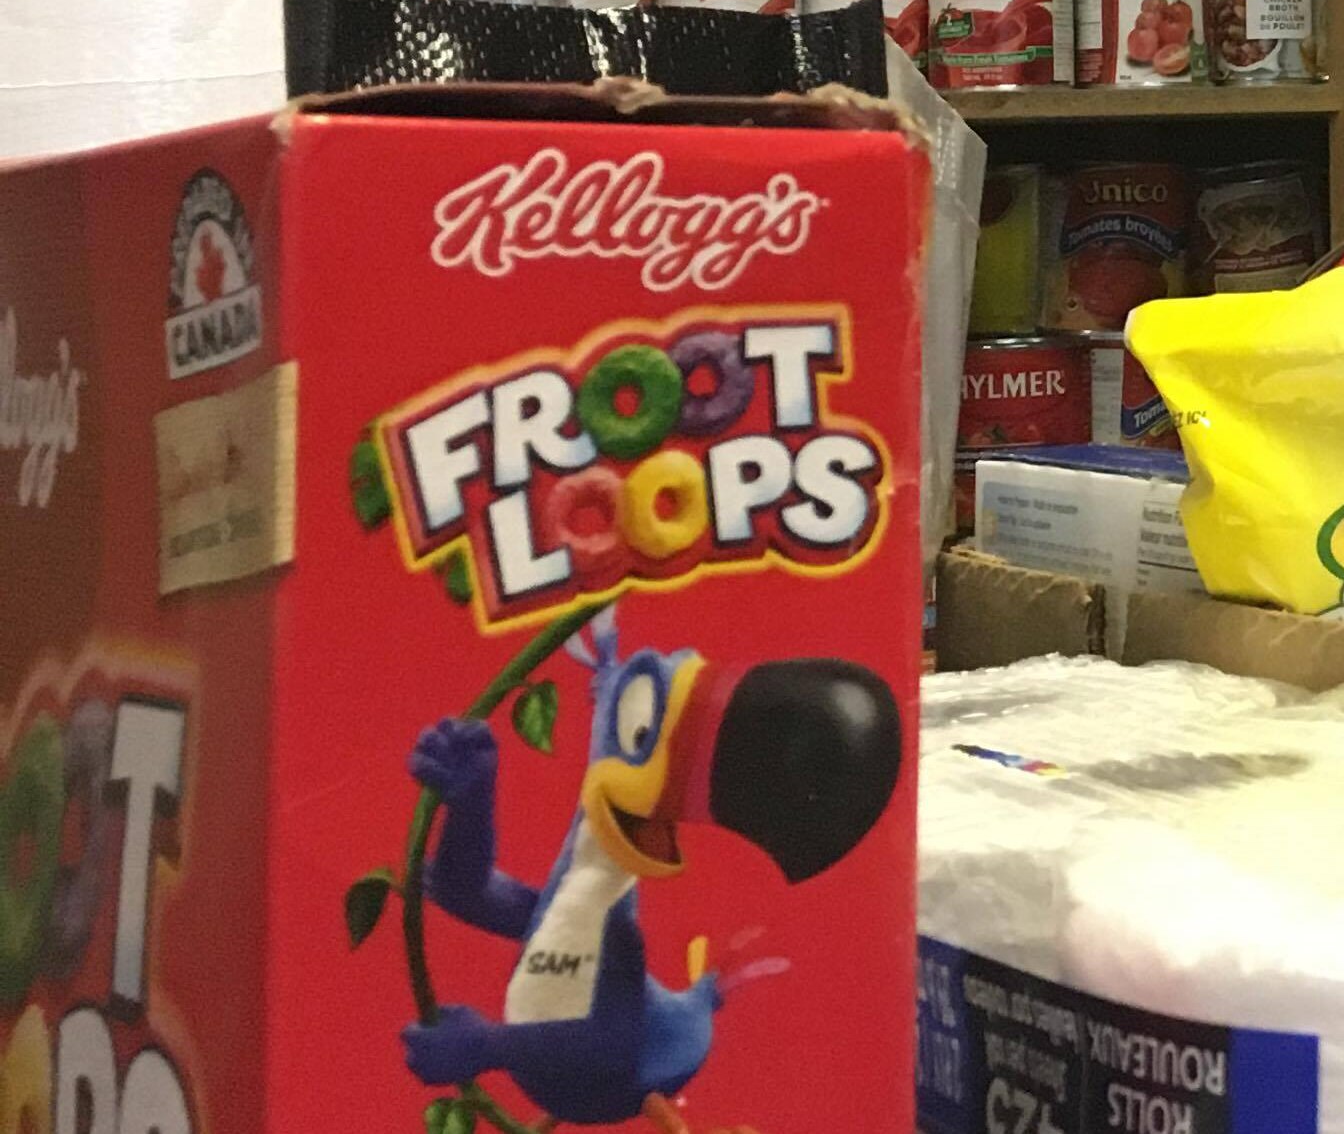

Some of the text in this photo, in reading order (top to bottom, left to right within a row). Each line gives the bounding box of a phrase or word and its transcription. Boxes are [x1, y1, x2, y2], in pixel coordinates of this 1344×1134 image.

[1260, 13, 1305, 23] BOUILLON
[1268, 4, 1299, 13] BROTH
[1273, 22, 1305, 32] POULET
[430, 148, 818, 292] Kellogg's
[406, 325, 834, 534] FROOT
[488, 436, 878, 598] LOOPS
[1086, 1019, 1228, 1097] ROULEAUX
